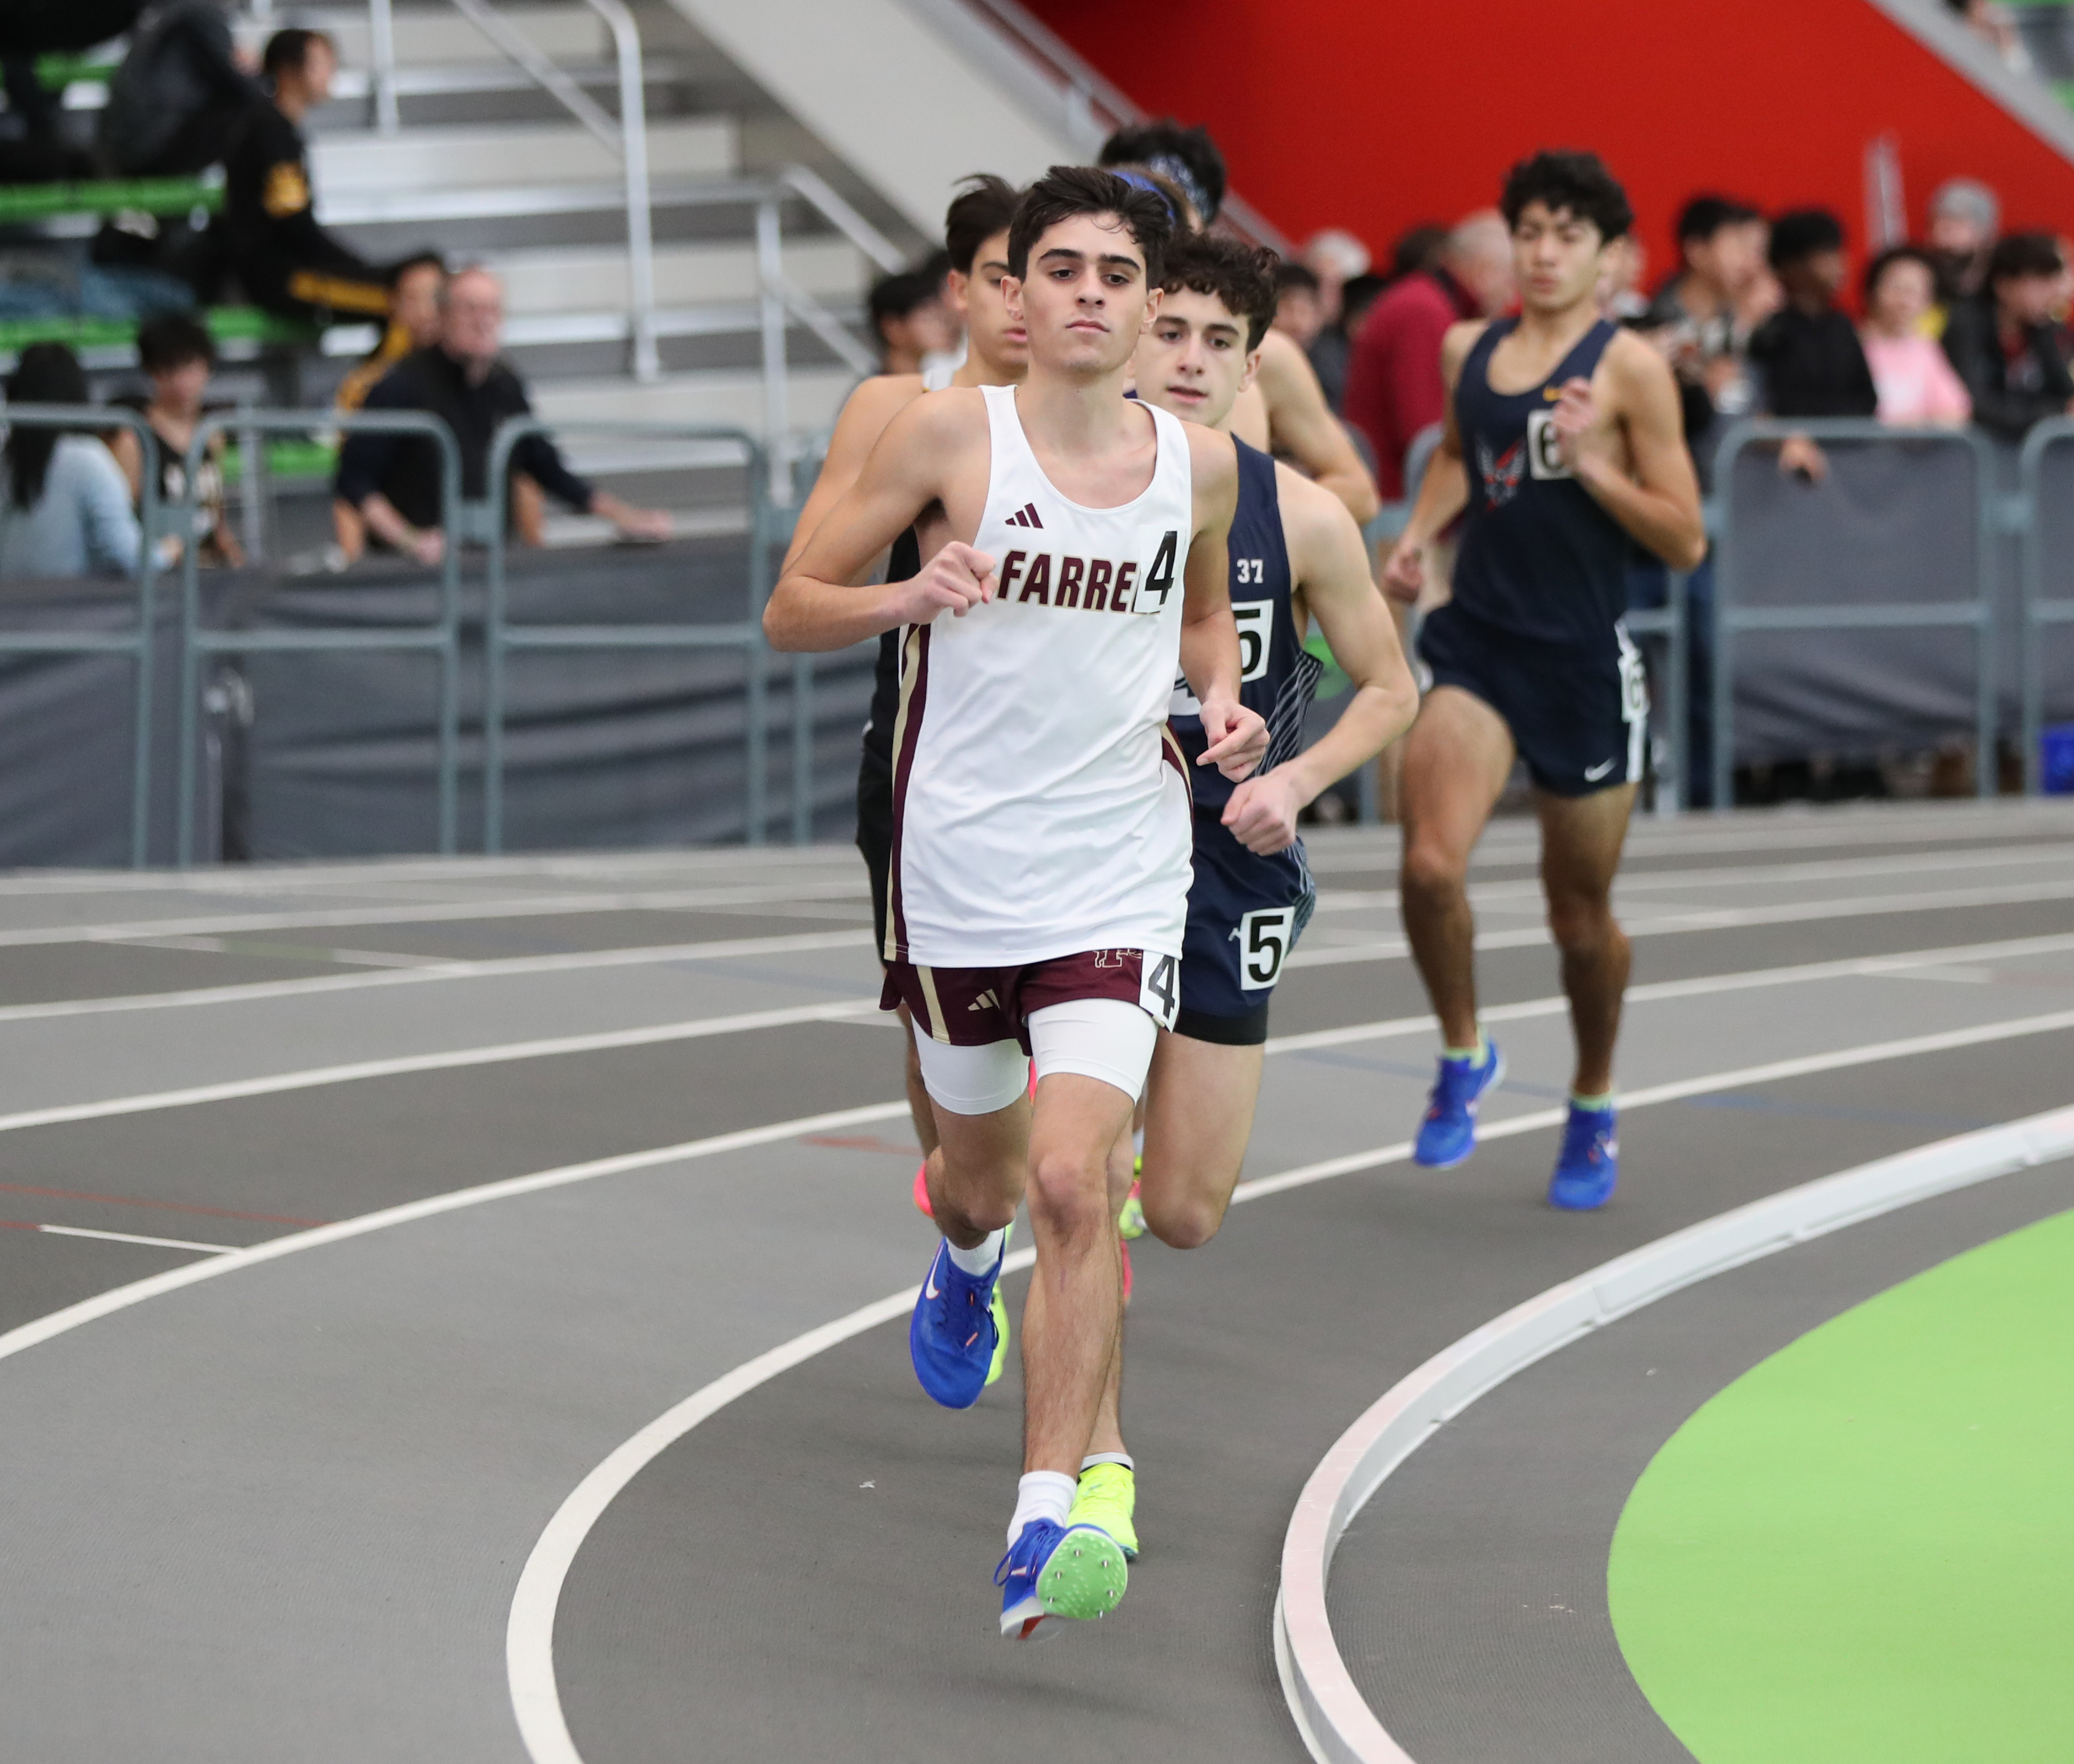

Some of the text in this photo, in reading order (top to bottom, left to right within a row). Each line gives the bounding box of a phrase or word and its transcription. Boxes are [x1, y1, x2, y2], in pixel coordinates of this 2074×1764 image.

[996, 548, 1160, 615] FARRE
[1145, 531, 1178, 605] 4
[1236, 558, 1264, 584] 37
[1248, 915, 1283, 982] 5
[1148, 954, 1175, 1020] 4
